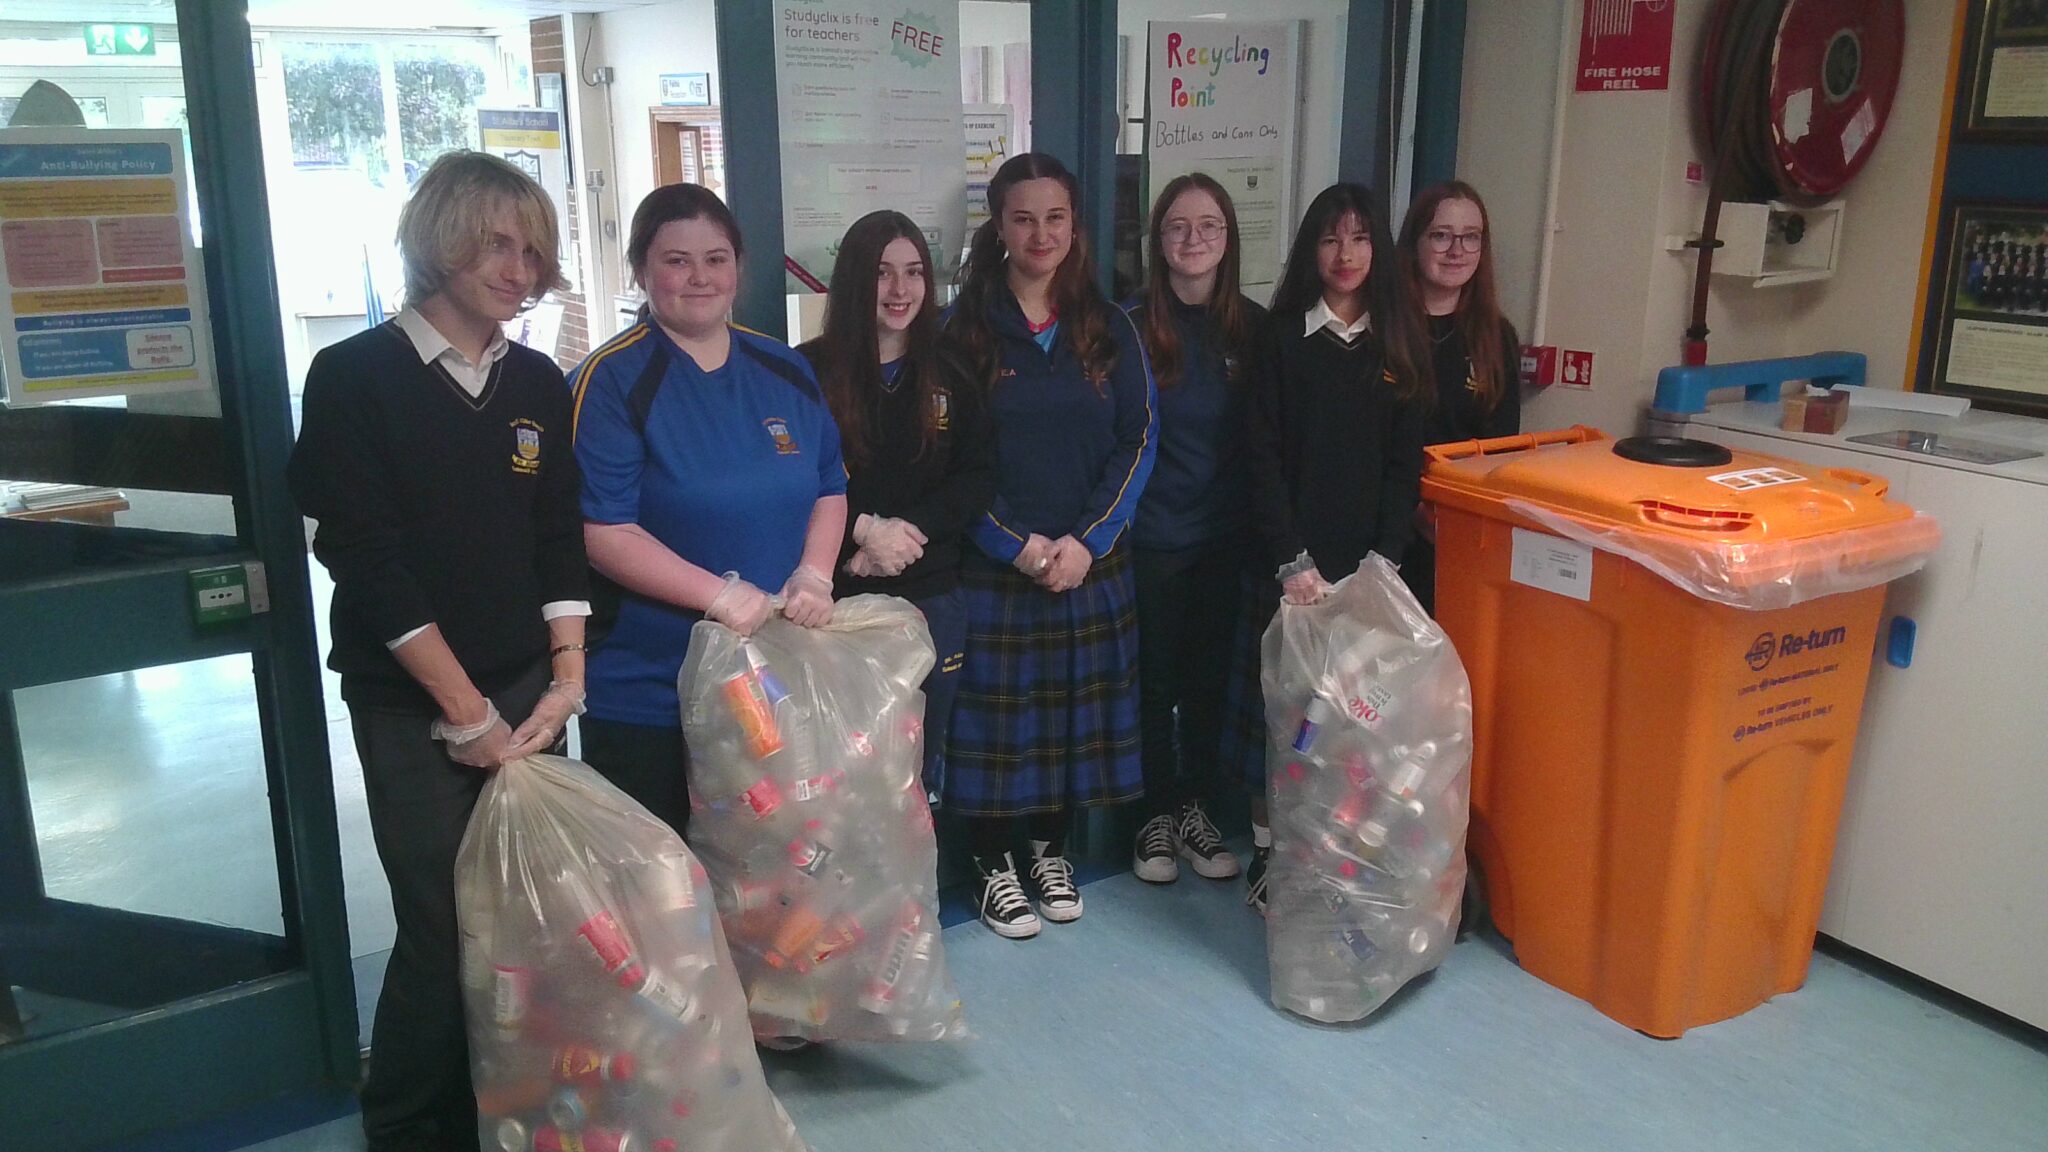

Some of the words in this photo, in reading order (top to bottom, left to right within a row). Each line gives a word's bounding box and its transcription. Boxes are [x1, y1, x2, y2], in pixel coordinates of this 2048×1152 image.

[784, 8, 839, 25] Studyclix
[842, 11, 852, 24] is
[855, 12, 880, 26] free
[785, 25, 804, 38] for
[808, 27, 861, 42] teachers
[891, 21, 944, 57] FREE
[1167, 32, 1270, 77] Recycling
[1584, 67, 1617, 78] FIRE
[1621, 66, 1661, 77] HOSE
[1171, 77, 1216, 107] Point
[1602, 79, 1640, 89] REEL
[1155, 120, 1204, 148] Bottles
[1211, 126, 1228, 140] and
[1231, 126, 1254, 140] Cans
[1259, 124, 1278, 139] Only
[40, 159, 119, 171] Anti-Bullying
[121, 158, 156, 170] Policy
[1778, 626, 1846, 658] Re-turn
[1774, 710, 1811, 726] VEHICLES
[1812, 704, 1834, 717] ONLY
